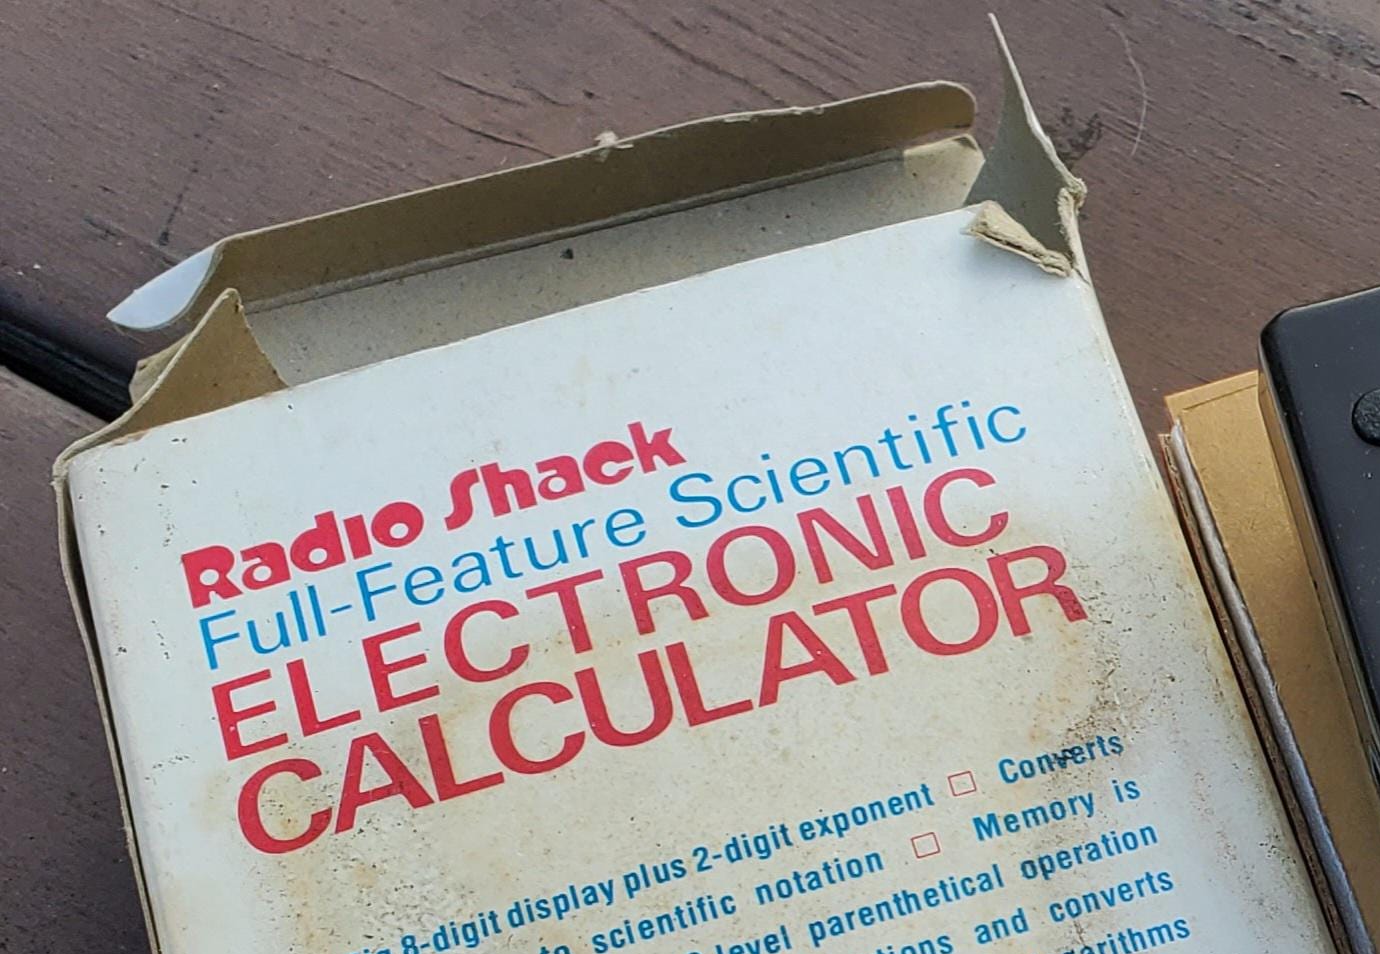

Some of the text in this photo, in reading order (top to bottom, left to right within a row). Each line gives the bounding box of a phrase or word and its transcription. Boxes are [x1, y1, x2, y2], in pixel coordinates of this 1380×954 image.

[181, 421, 688, 608] Radio Shack
[198, 401, 1028, 670] Full-Feature Scientific
[211, 467, 1010, 761] ELECTRONIC
[236, 545, 1088, 855] CALCULATOR
[507, 879, 615, 929] display
[623, 855, 687, 900] plus
[693, 822, 794, 874] 2-digit
[799, 782, 936, 843] exponent
[998, 733, 1125, 784] Converts
[591, 894, 737, 954] scientific
[755, 849, 884, 905] notation
[972, 792, 1096, 841] Memory
[1112, 778, 1141, 803] is
[809, 864, 1004, 949] parenthetical
[1020, 822, 1158, 881] operation
[974, 908, 1030, 945] and
[1048, 868, 1174, 924] converts
